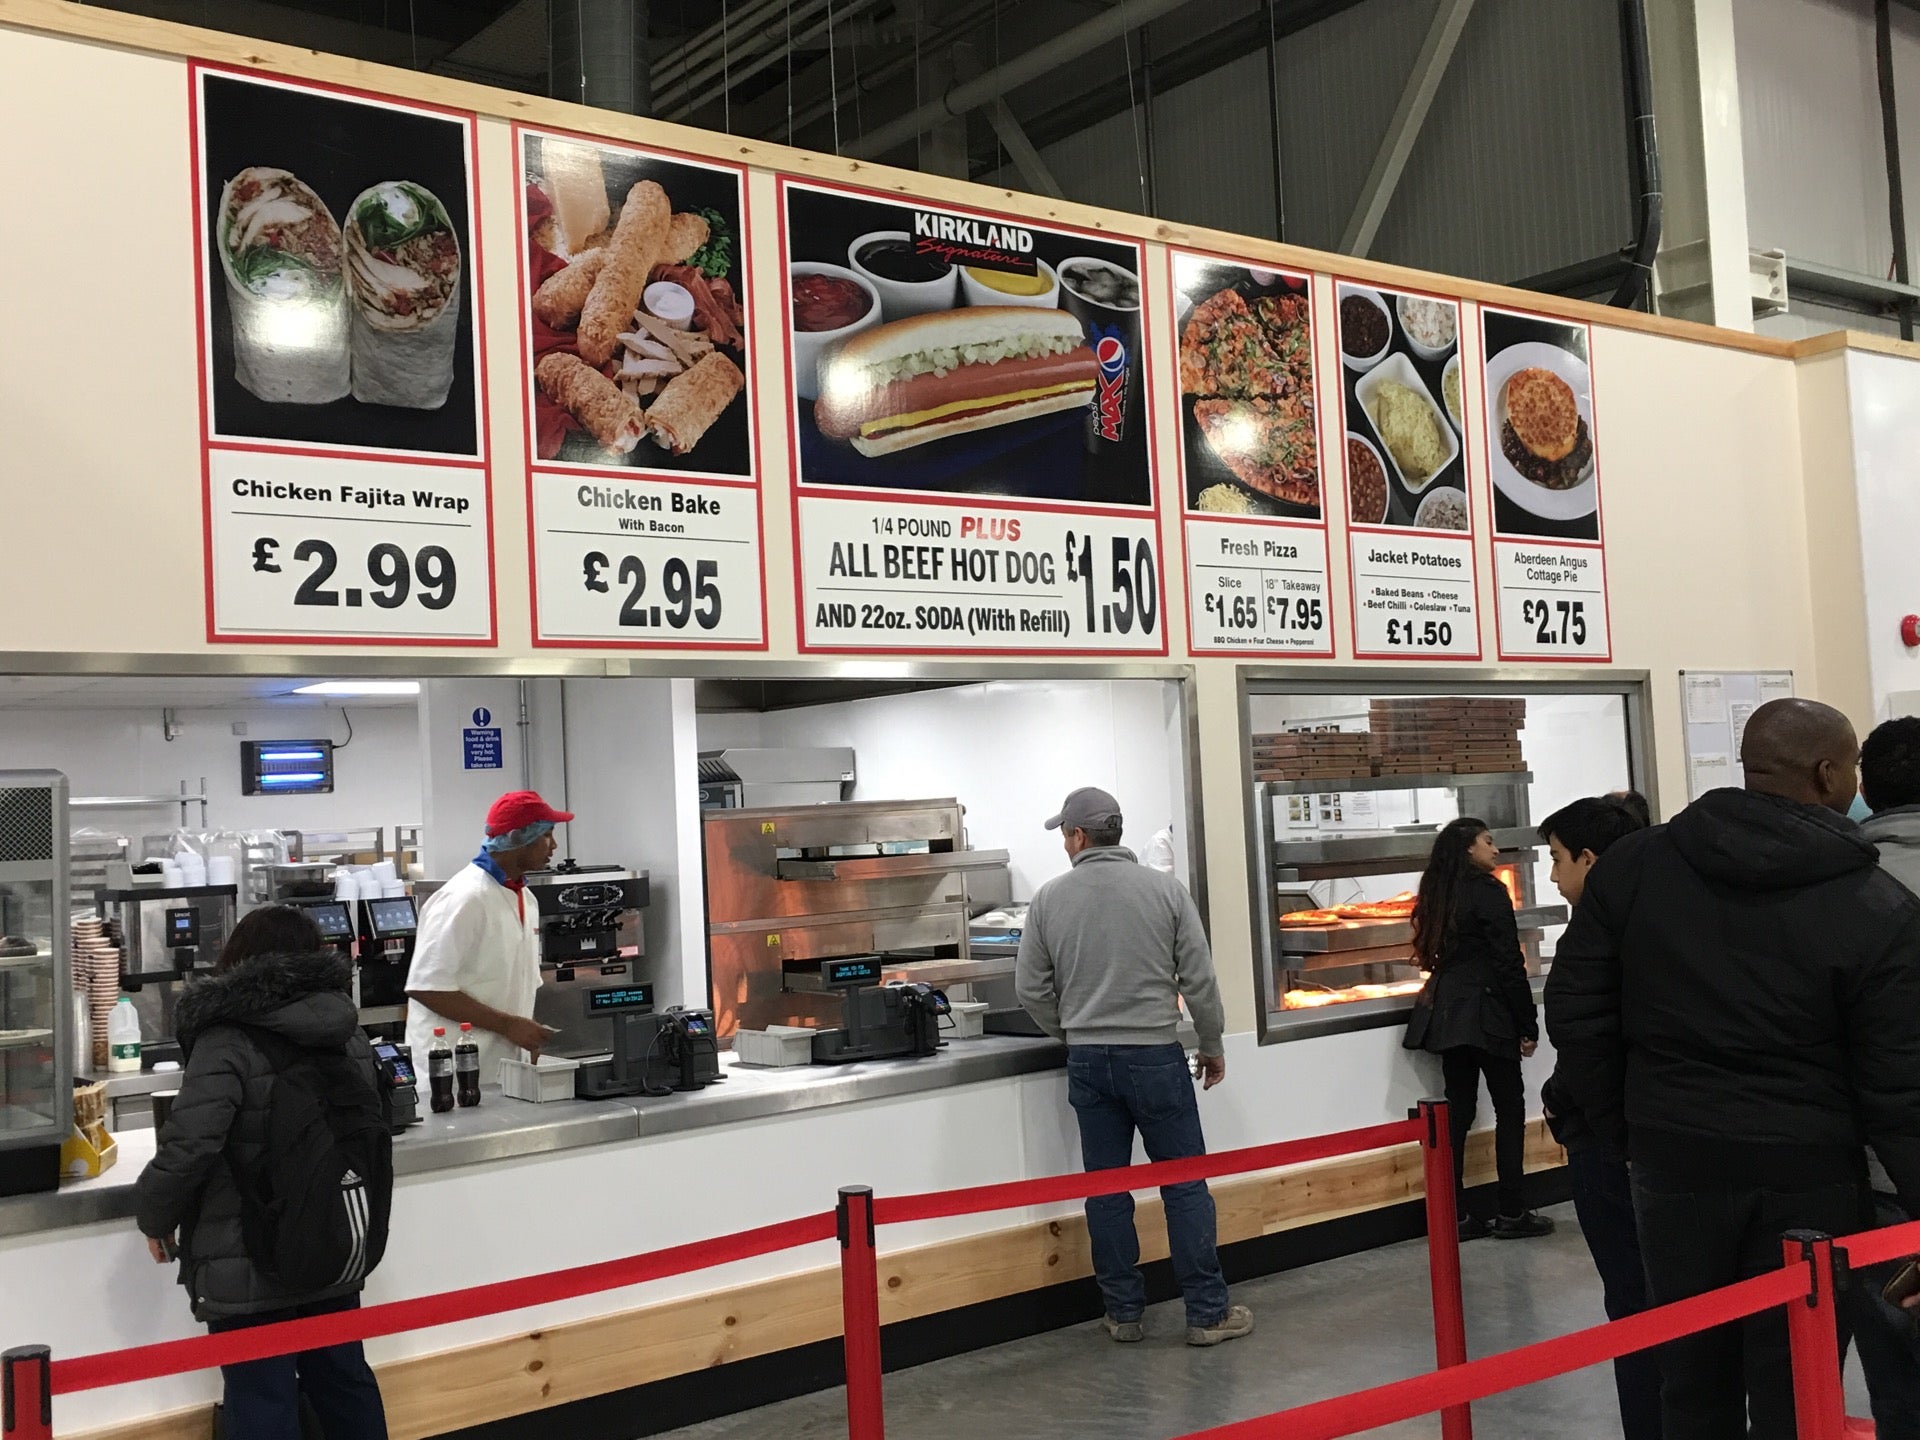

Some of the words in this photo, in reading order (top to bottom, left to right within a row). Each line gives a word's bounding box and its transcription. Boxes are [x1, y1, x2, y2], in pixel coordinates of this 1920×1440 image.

[914, 212, 1033, 253] KIRKLAND
[916, 238, 1033, 263] Signature
[1091, 401, 1100, 436] pepsi
[1099, 367, 1124, 441] MAX
[231, 479, 333, 503] Chicken
[340, 486, 406, 509] Fajita
[413, 490, 470, 514] Wrap
[577, 485, 663, 511] Chicken
[671, 492, 721, 515] Bake
[618, 518, 645, 532] With
[649, 519, 685, 534] Bacon
[872, 517, 893, 535] 1/4
[898, 518, 951, 538] POUND
[960, 516, 1021, 542] PLUS
[1221, 538, 1259, 556] Fresh
[1264, 541, 1298, 558] Pizza
[1368, 549, 1408, 565] Jacket
[1411, 552, 1462, 568] Potatoes
[1514, 552, 1557, 566] Aberdeen
[1559, 554, 1588, 570] Angus
[251, 537, 457, 610] £2.99
[830, 541, 878, 578] ALL
[884, 544, 944, 580] BEEF
[951, 547, 1000, 583] HOT
[1006, 551, 1056, 585] DOG
[1527, 568, 1562, 584] Cottage
[1564, 570, 1578, 582] Pie
[583, 551, 722, 630] £2.95
[1065, 530, 1156, 635] £1.50
[1218, 576, 1242, 588] Slice
[1282, 579, 1321, 593] Takeaway
[1375, 587, 1399, 597] Baked
[1401, 589, 1424, 599] Beans
[1431, 590, 1459, 601] Cheese
[816, 603, 856, 628] AND
[861, 604, 911, 630] 22oz.
[915, 606, 964, 630] SODA
[968, 608, 1015, 636] (With
[1020, 609, 1070, 638] Refill)
[1205, 593, 1258, 629] £1.65
[1267, 596, 1323, 630] £7.95
[1367, 600, 1386, 609] Beef
[1387, 601, 1407, 610] Chilli
[1413, 602, 1447, 612] Coleslaw
[1453, 604, 1471, 614] Tuna
[1387, 618, 1452, 646] £1.50
[1523, 599, 1587, 645] £2.75
[1213, 636, 1225, 644] BBQ
[1226, 636, 1247, 644] Chicken
[1253, 637, 1264, 645] Four
[1266, 637, 1284, 645] Cheese
[1290, 638, 1314, 646] Pepperoni
